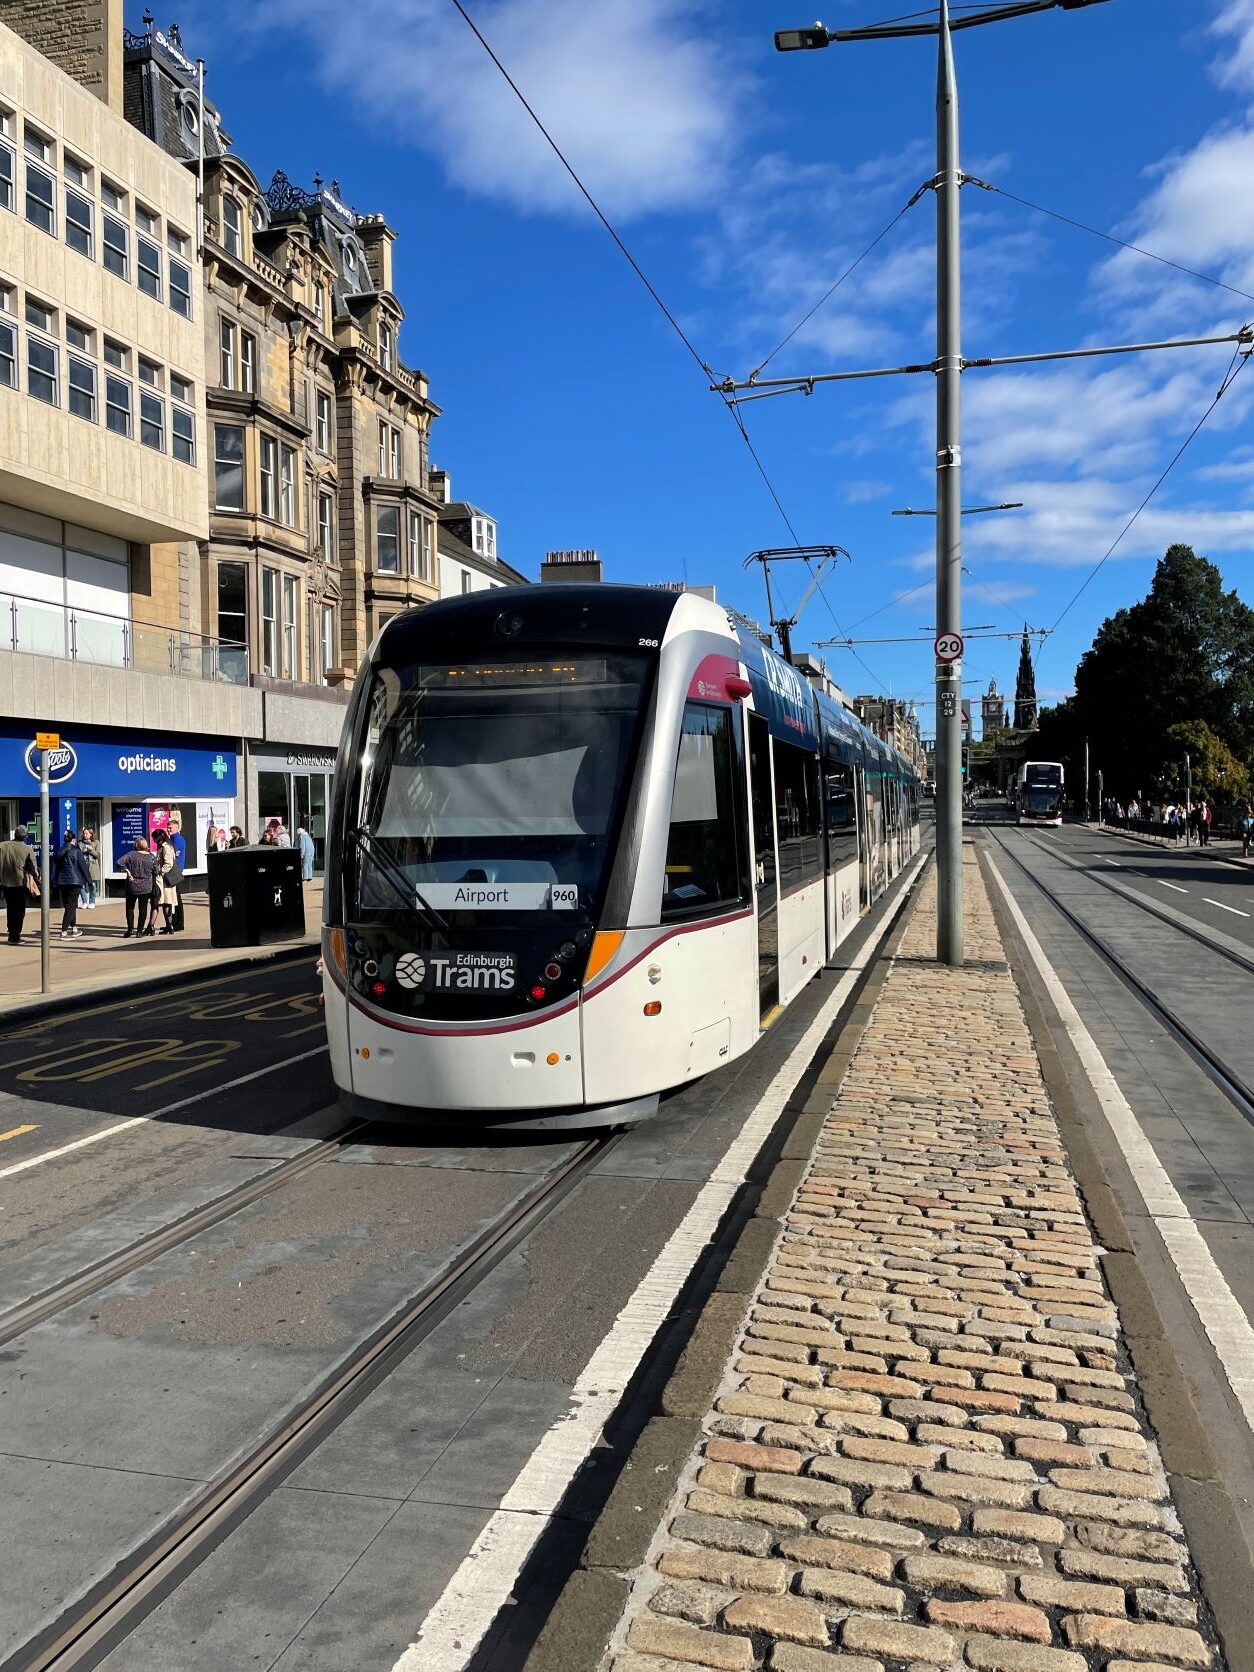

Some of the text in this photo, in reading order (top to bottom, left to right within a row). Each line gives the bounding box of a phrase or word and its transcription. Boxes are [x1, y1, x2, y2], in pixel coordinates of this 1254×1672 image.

[638, 638, 659, 647] 266
[939, 641, 960, 653] 20
[943, 708, 953, 716] 29
[118, 753, 177, 774] opticians
[297, 752, 335, 767] SWAROVSKI
[455, 887, 576, 905] Airport 960
[456, 954, 514, 969] Edinburgh
[429, 959, 516, 989] Trams
